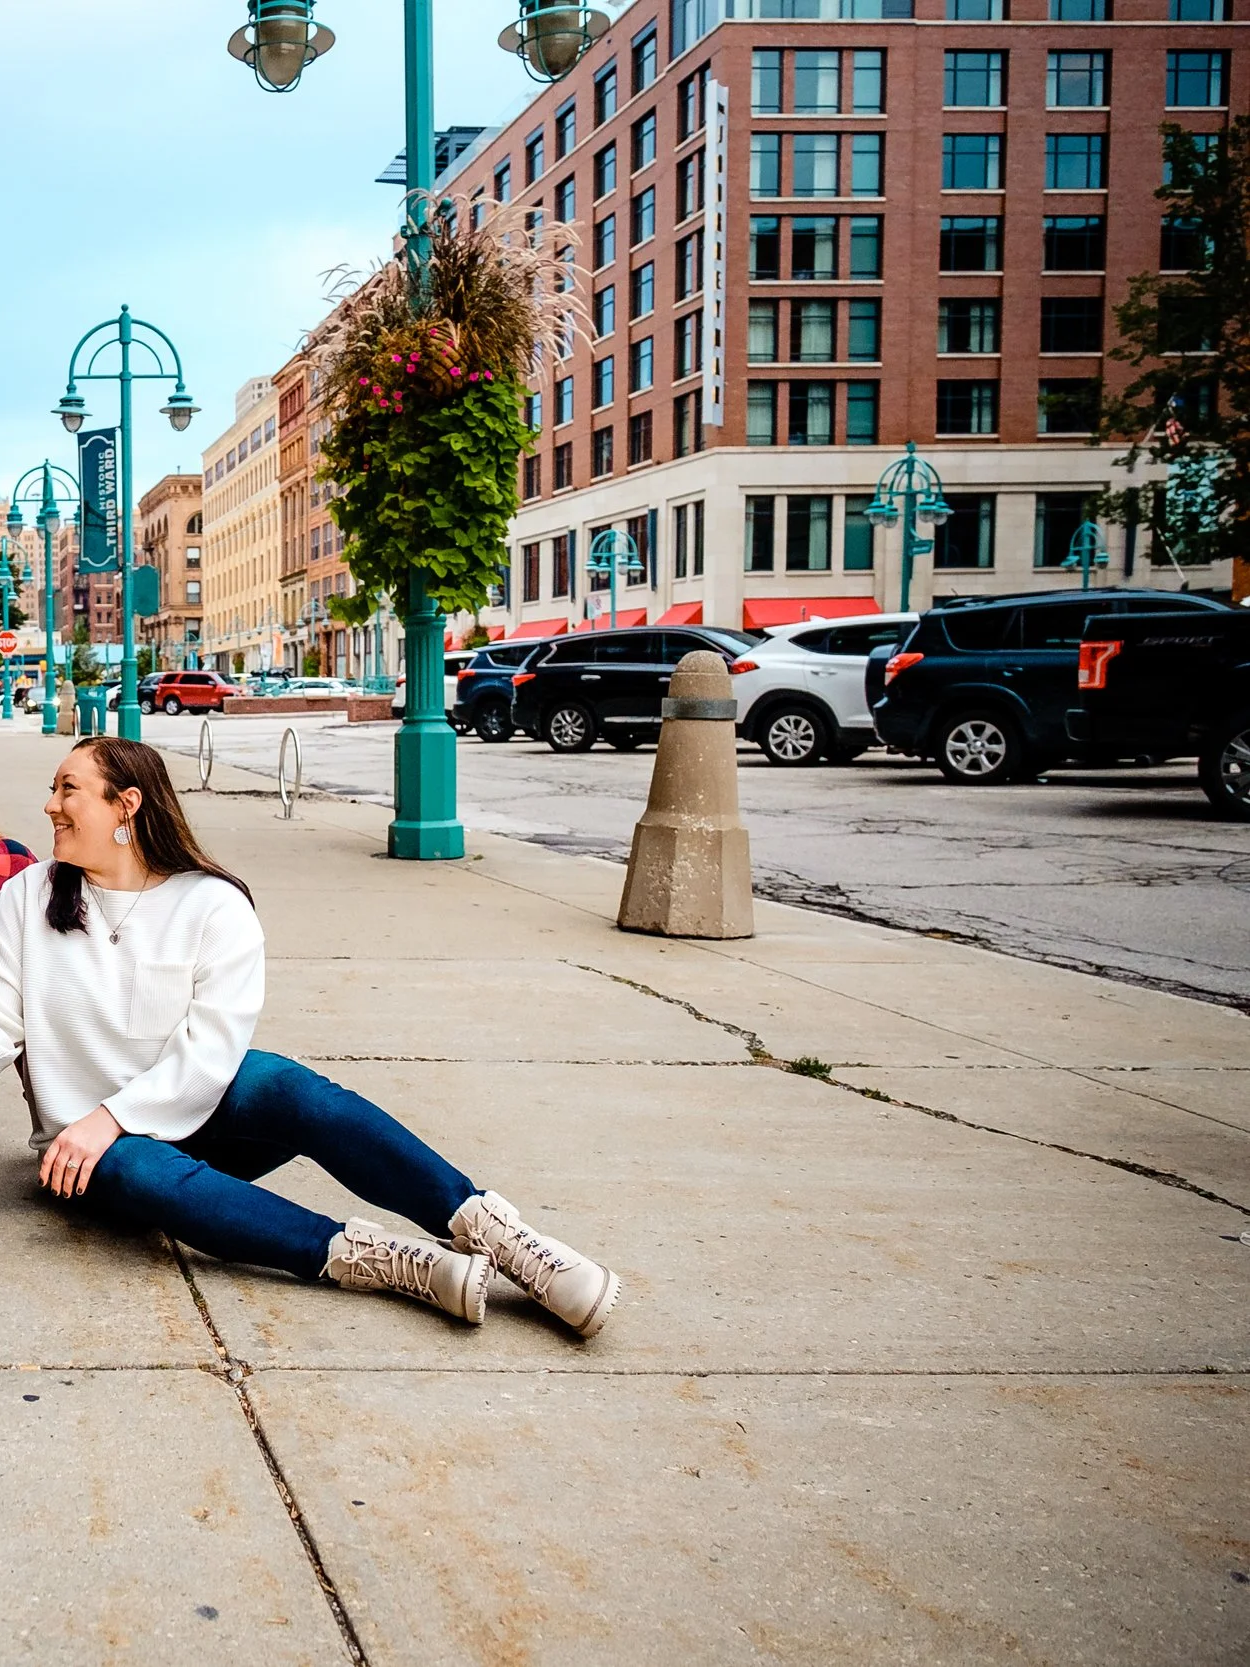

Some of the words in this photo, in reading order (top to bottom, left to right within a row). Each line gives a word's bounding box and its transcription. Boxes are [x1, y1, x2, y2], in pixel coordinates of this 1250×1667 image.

[105, 449, 115, 497] WARD
[106, 499, 117, 547] THIRD
[1139, 635, 1224, 646] SPORT
